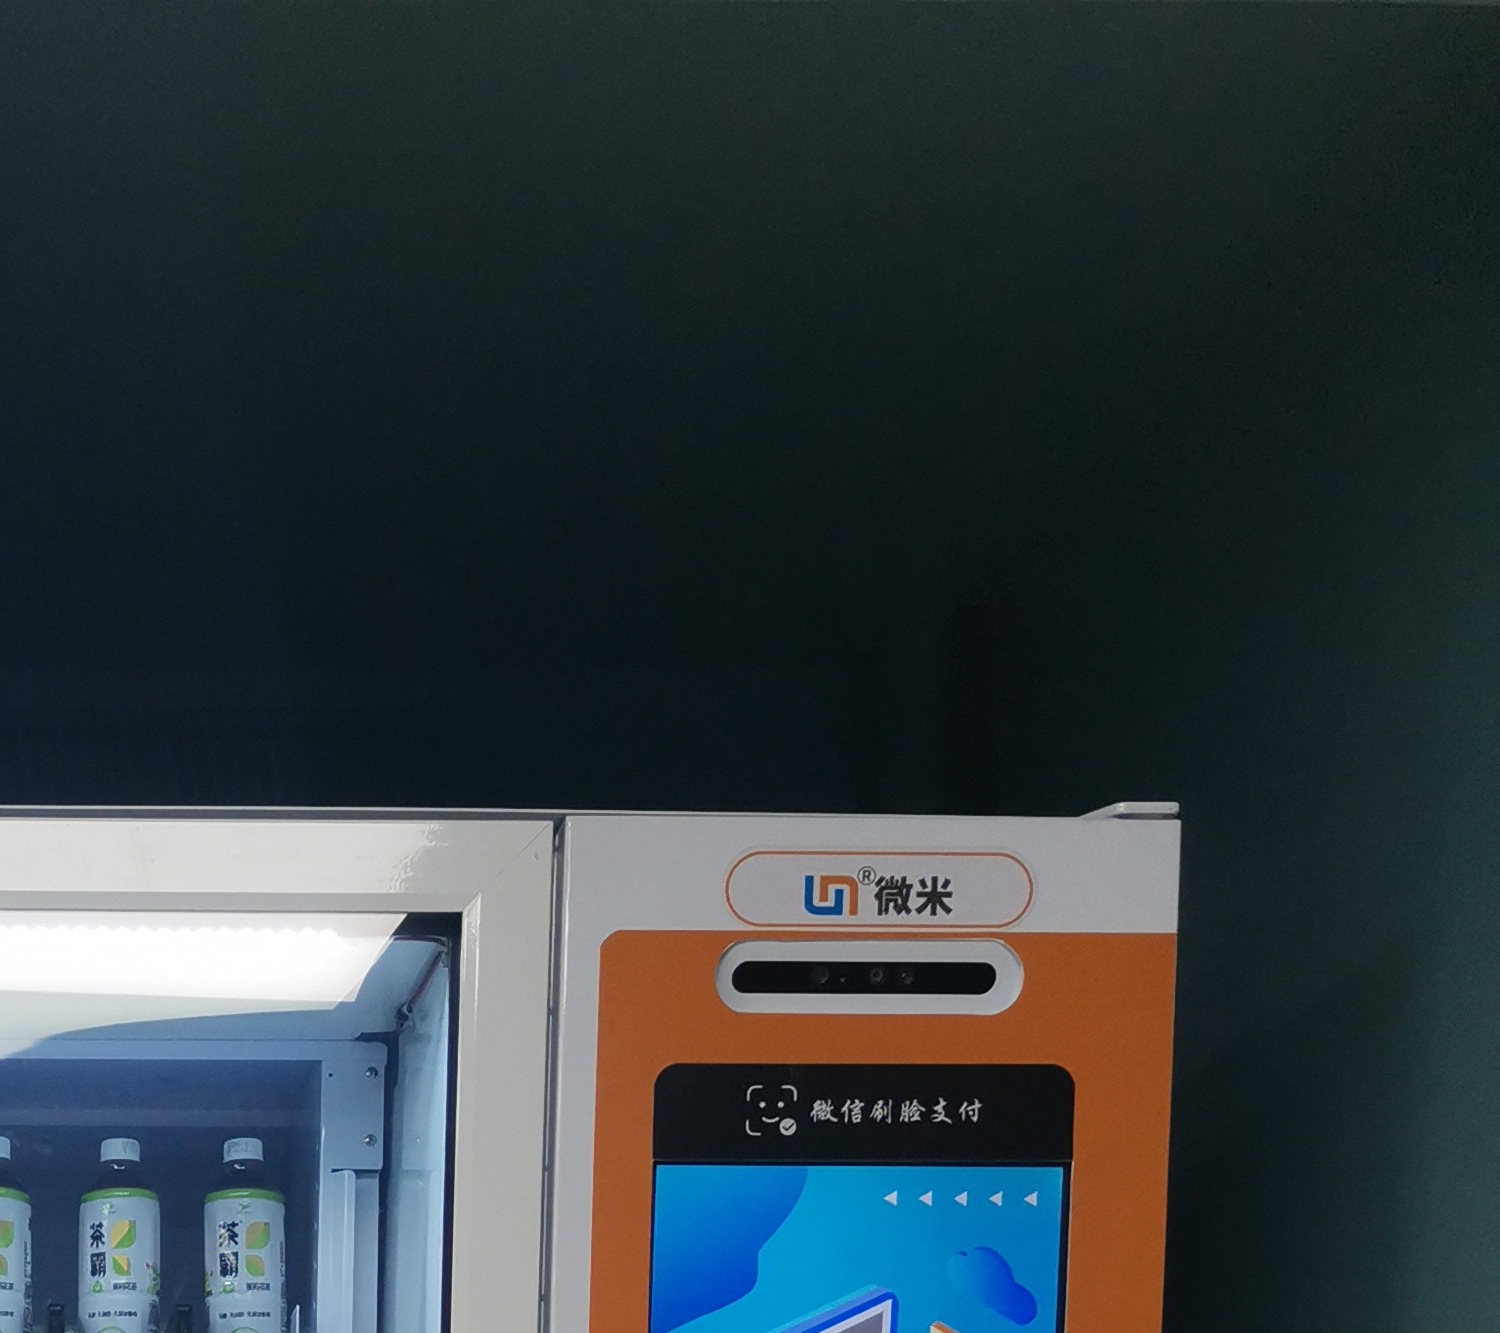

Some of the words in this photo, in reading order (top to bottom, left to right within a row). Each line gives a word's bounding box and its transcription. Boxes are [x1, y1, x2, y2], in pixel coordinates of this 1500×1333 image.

[873, 874, 954, 917] 微米
[809, 1097, 984, 1125] 微信刷脸支付
